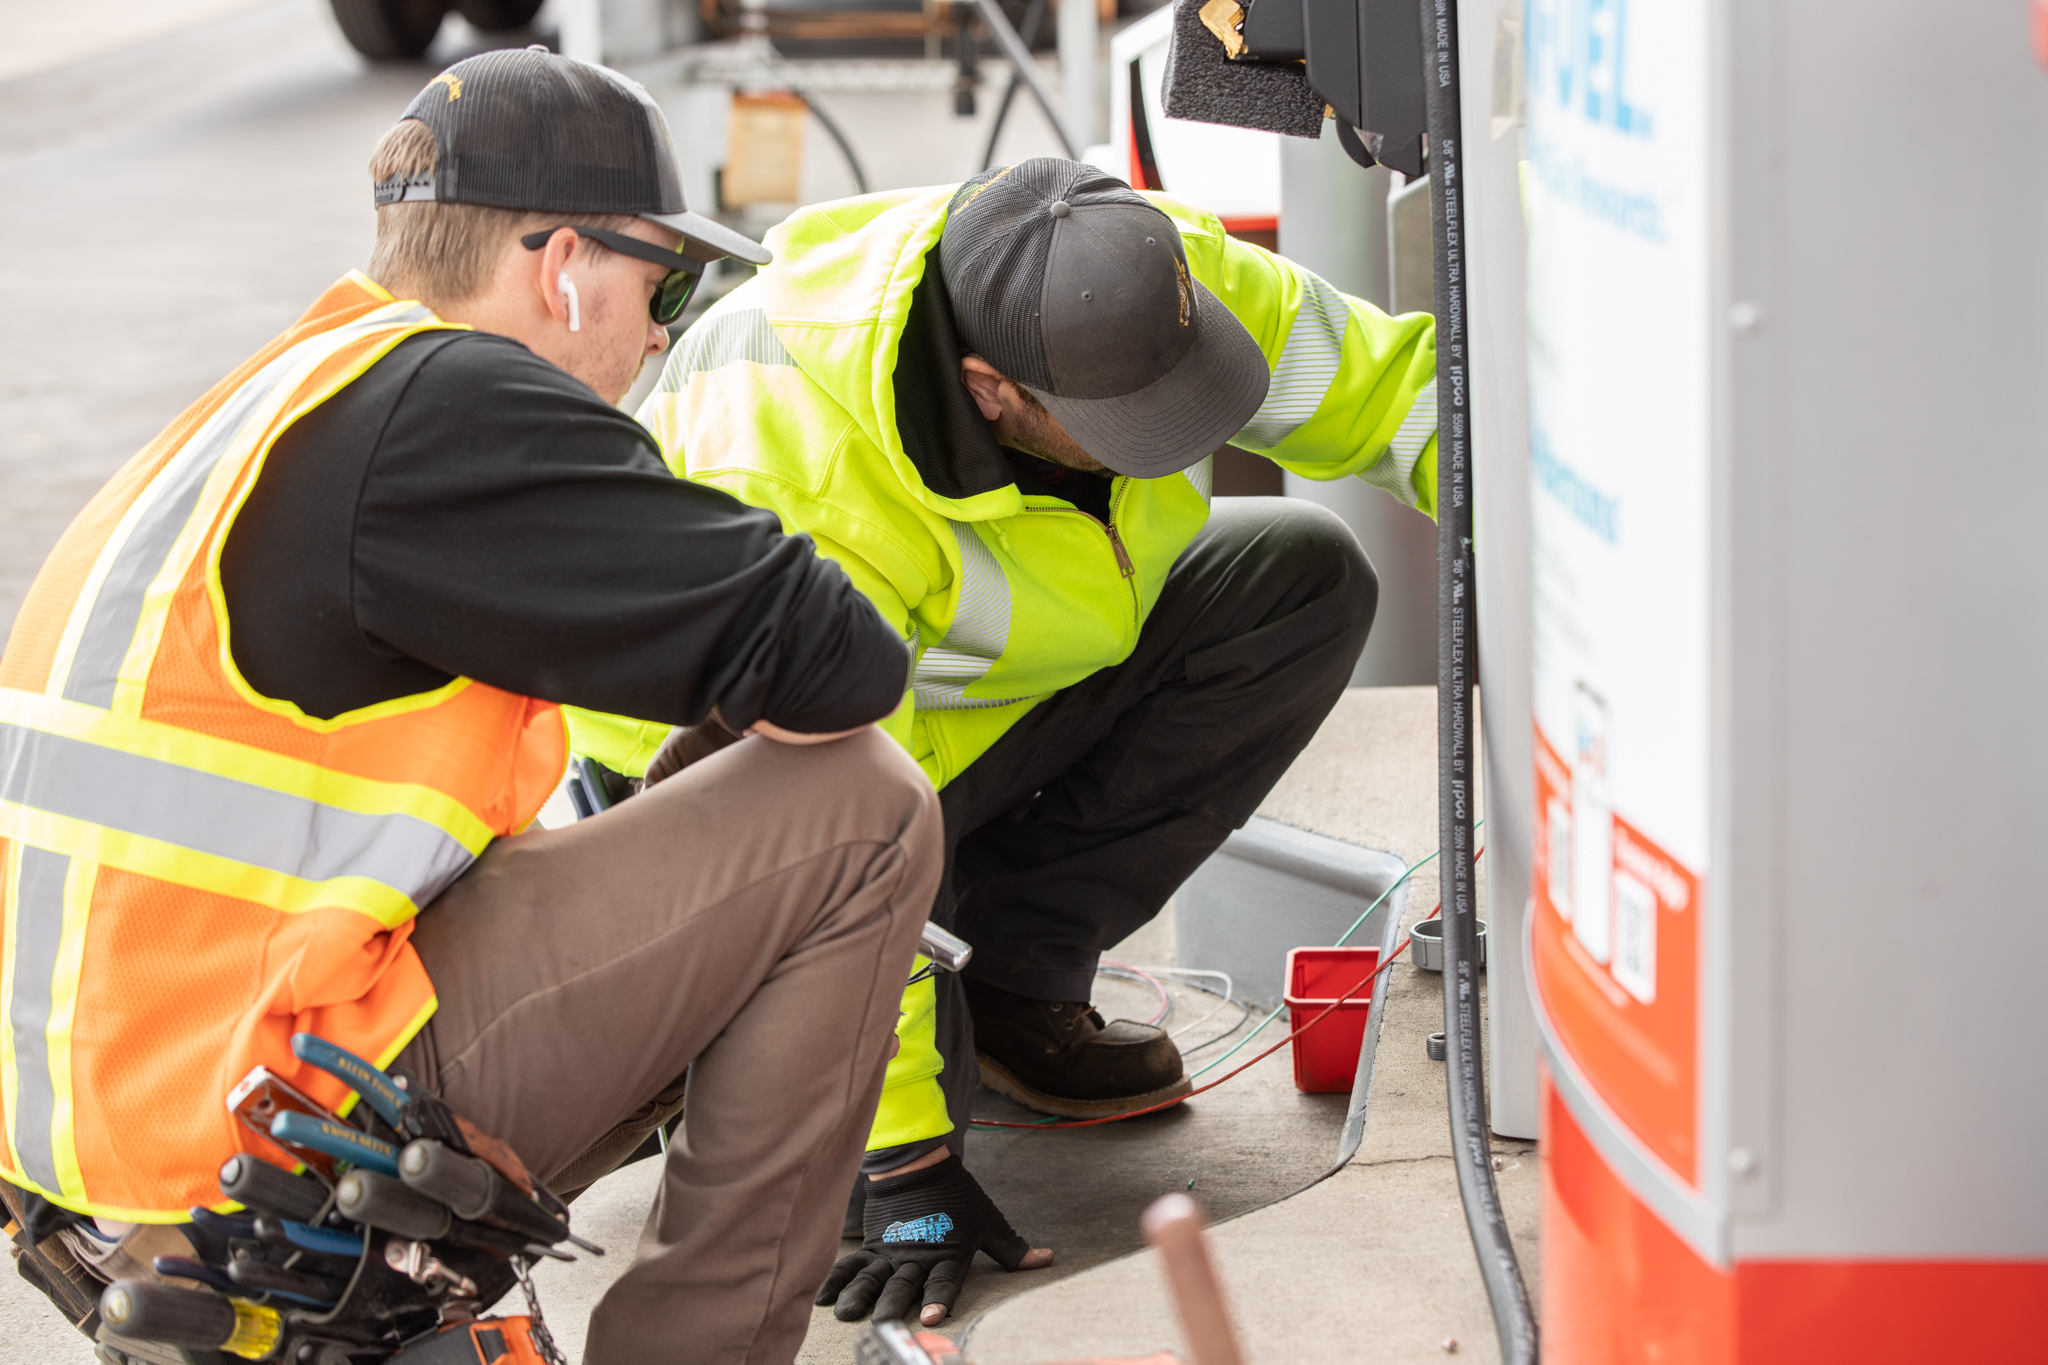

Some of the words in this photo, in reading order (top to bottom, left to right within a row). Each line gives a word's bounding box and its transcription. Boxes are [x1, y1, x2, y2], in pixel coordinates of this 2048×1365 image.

[1437, 19, 1448, 49] MADE
[1438, 52, 1448, 62] IN
[1439, 65, 1450, 87] USA
[1445, 188, 1458, 246] STEELFLEX
[1448, 249, 1459, 283] ULTRA
[1450, 286, 1461, 341] HARDWALL
[1451, 345, 1462, 358] BY
[1453, 413, 1463, 437] 559N
[1453, 441, 1463, 469] MADE
[1454, 473, 1463, 483] IN
[1453, 486, 1463, 507] USA
[1453, 607, 1463, 663] STEELFLEX
[1453, 667, 1463, 699] ULTRA
[1453, 702, 1464, 756] HARDWALL
[1454, 760, 1464, 773] BY
[1454, 826, 1464, 849] 559N
[1455, 851, 1466, 879] MADE
[1456, 882, 1466, 892] IN
[1456, 894, 1467, 914] USA
